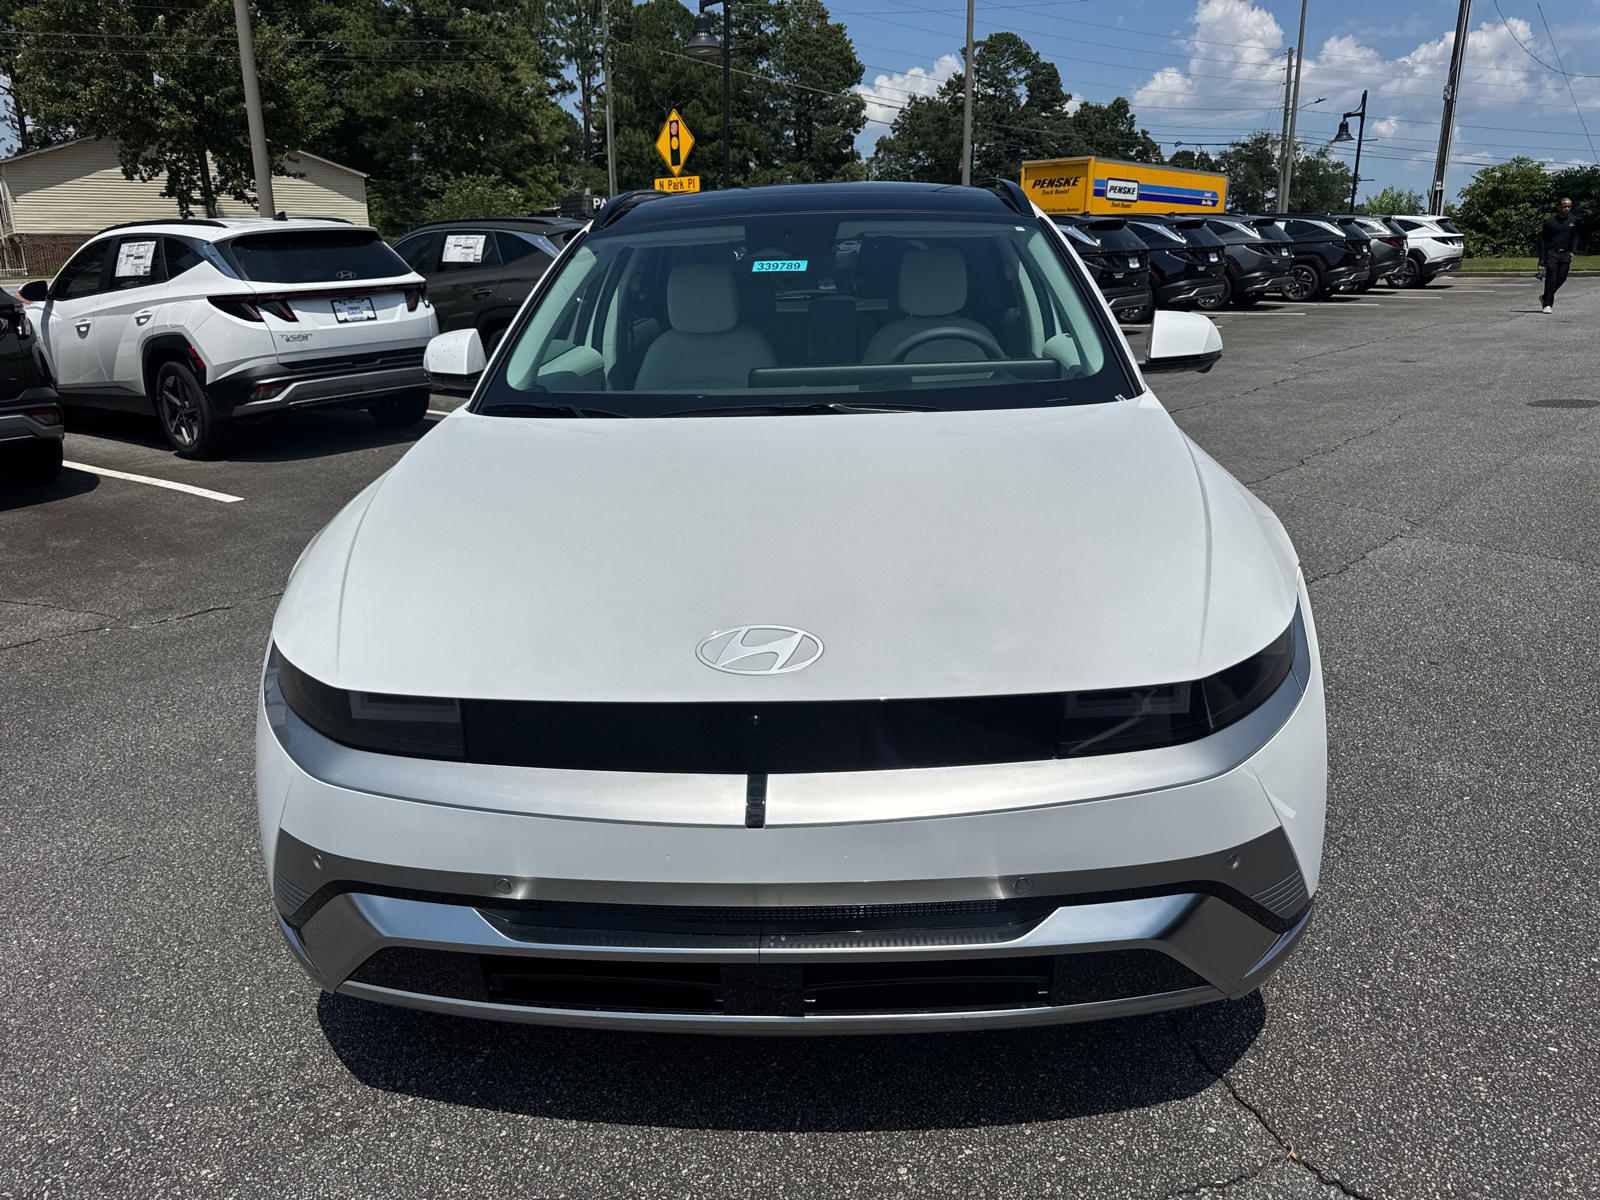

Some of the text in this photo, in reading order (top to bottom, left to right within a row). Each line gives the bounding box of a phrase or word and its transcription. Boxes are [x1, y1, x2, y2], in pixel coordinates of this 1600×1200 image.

[659, 178, 696, 190] N Park Pl
[1032, 176, 1081, 189] PENSKE
[1108, 185, 1136, 195] PENSKE
[757, 262, 801, 270] 339789
